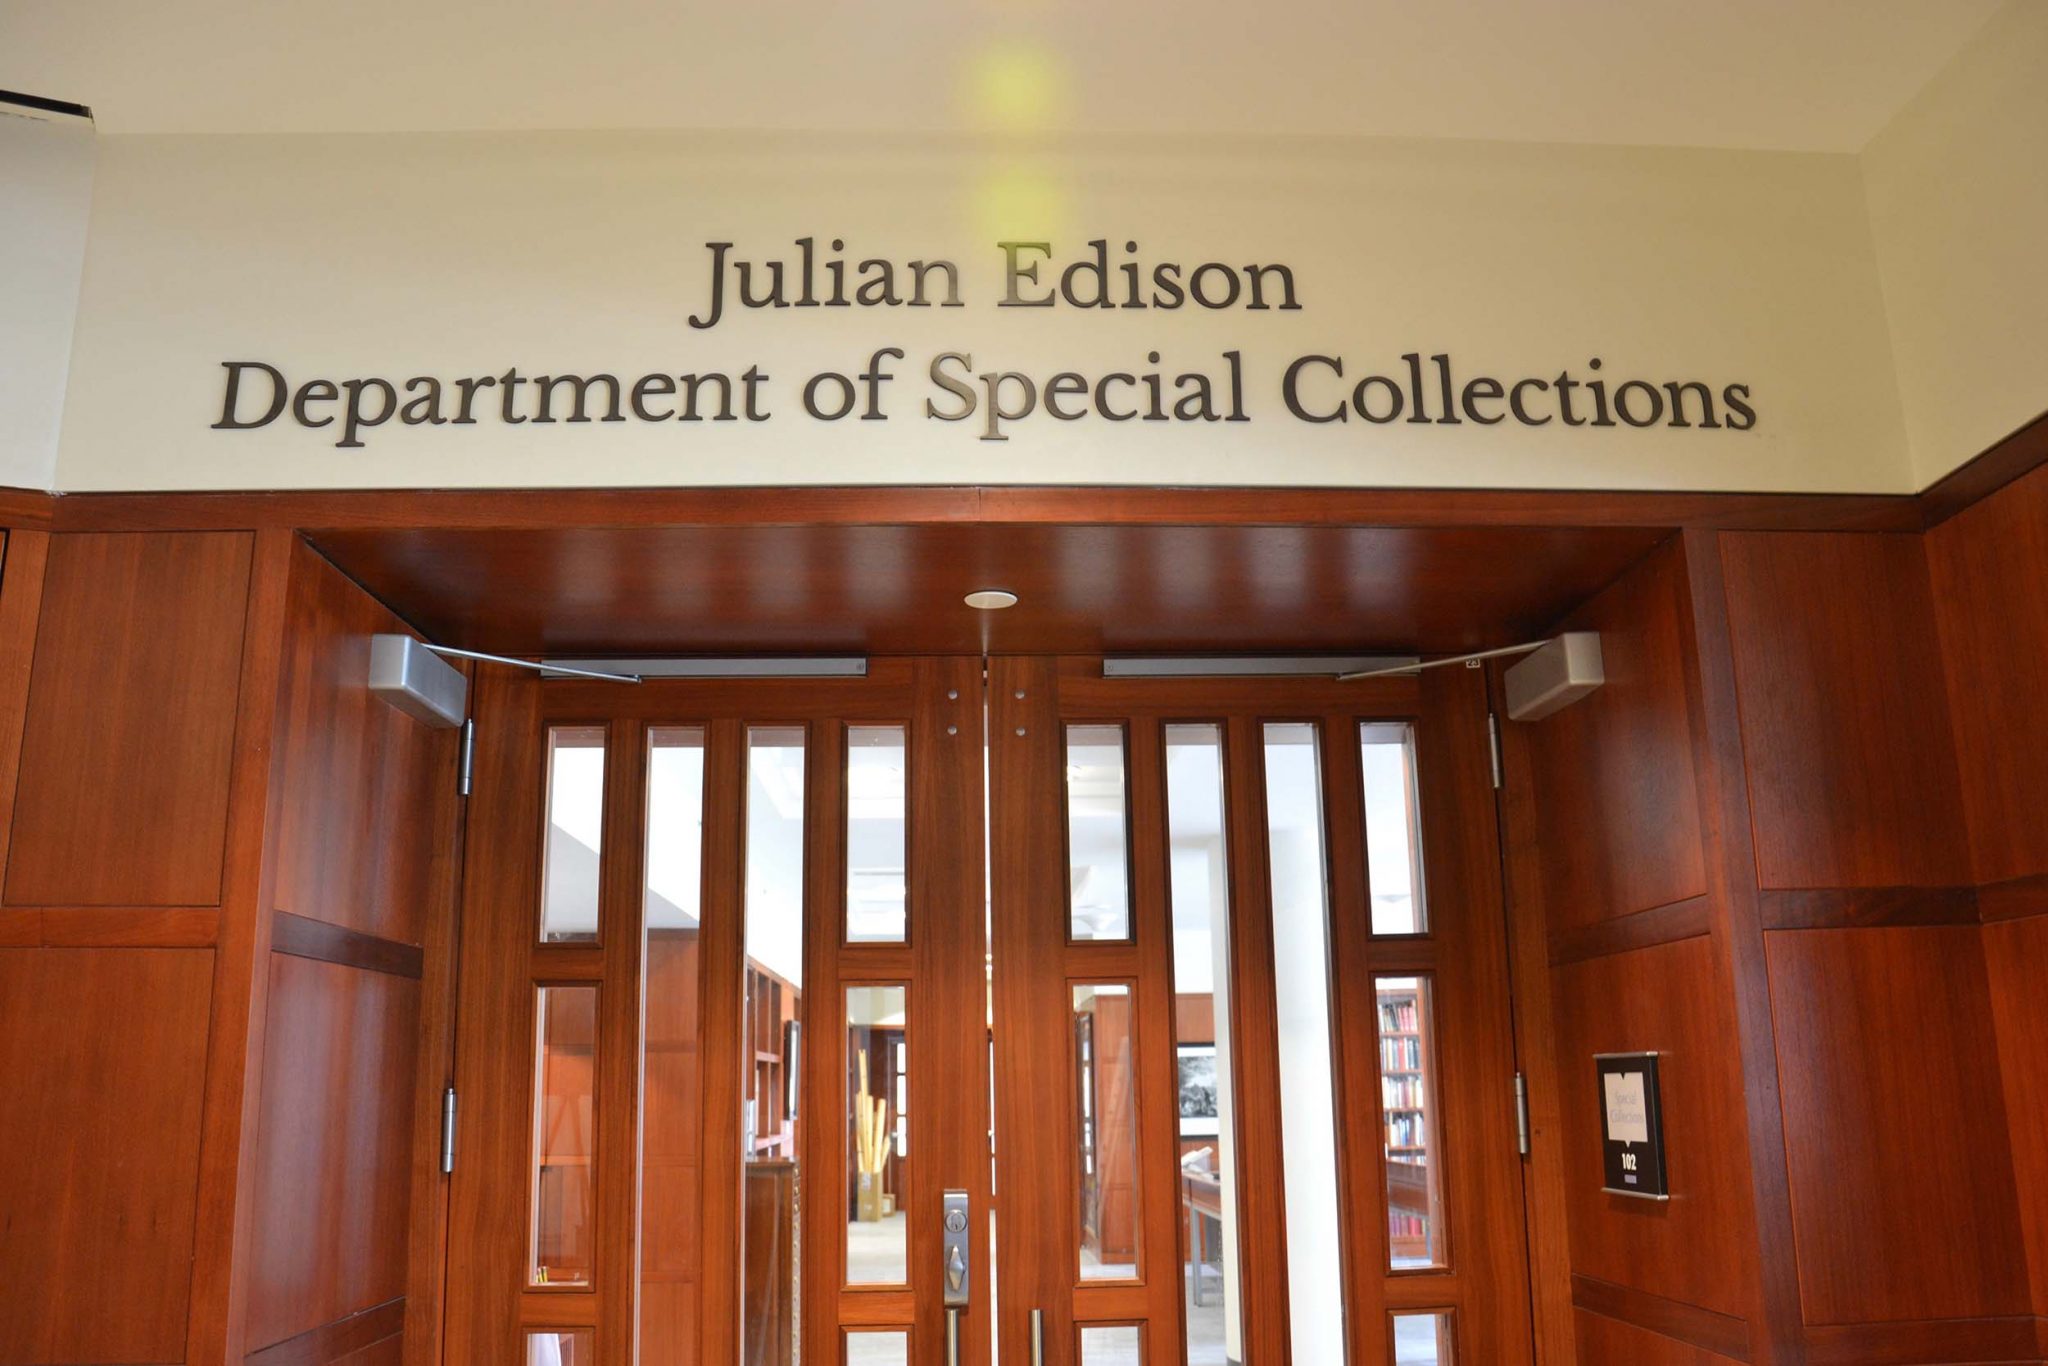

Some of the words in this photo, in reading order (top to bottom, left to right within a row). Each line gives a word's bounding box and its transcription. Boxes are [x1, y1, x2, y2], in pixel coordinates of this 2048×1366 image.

[687, 237, 966, 331] Julian
[996, 238, 1303, 310] Edison
[210, 361, 772, 449] Department
[800, 346, 906, 422] of
[925, 350, 1252, 442] Special
[1281, 350, 1758, 432] Collections
[1621, 1153, 1637, 1170] 102
